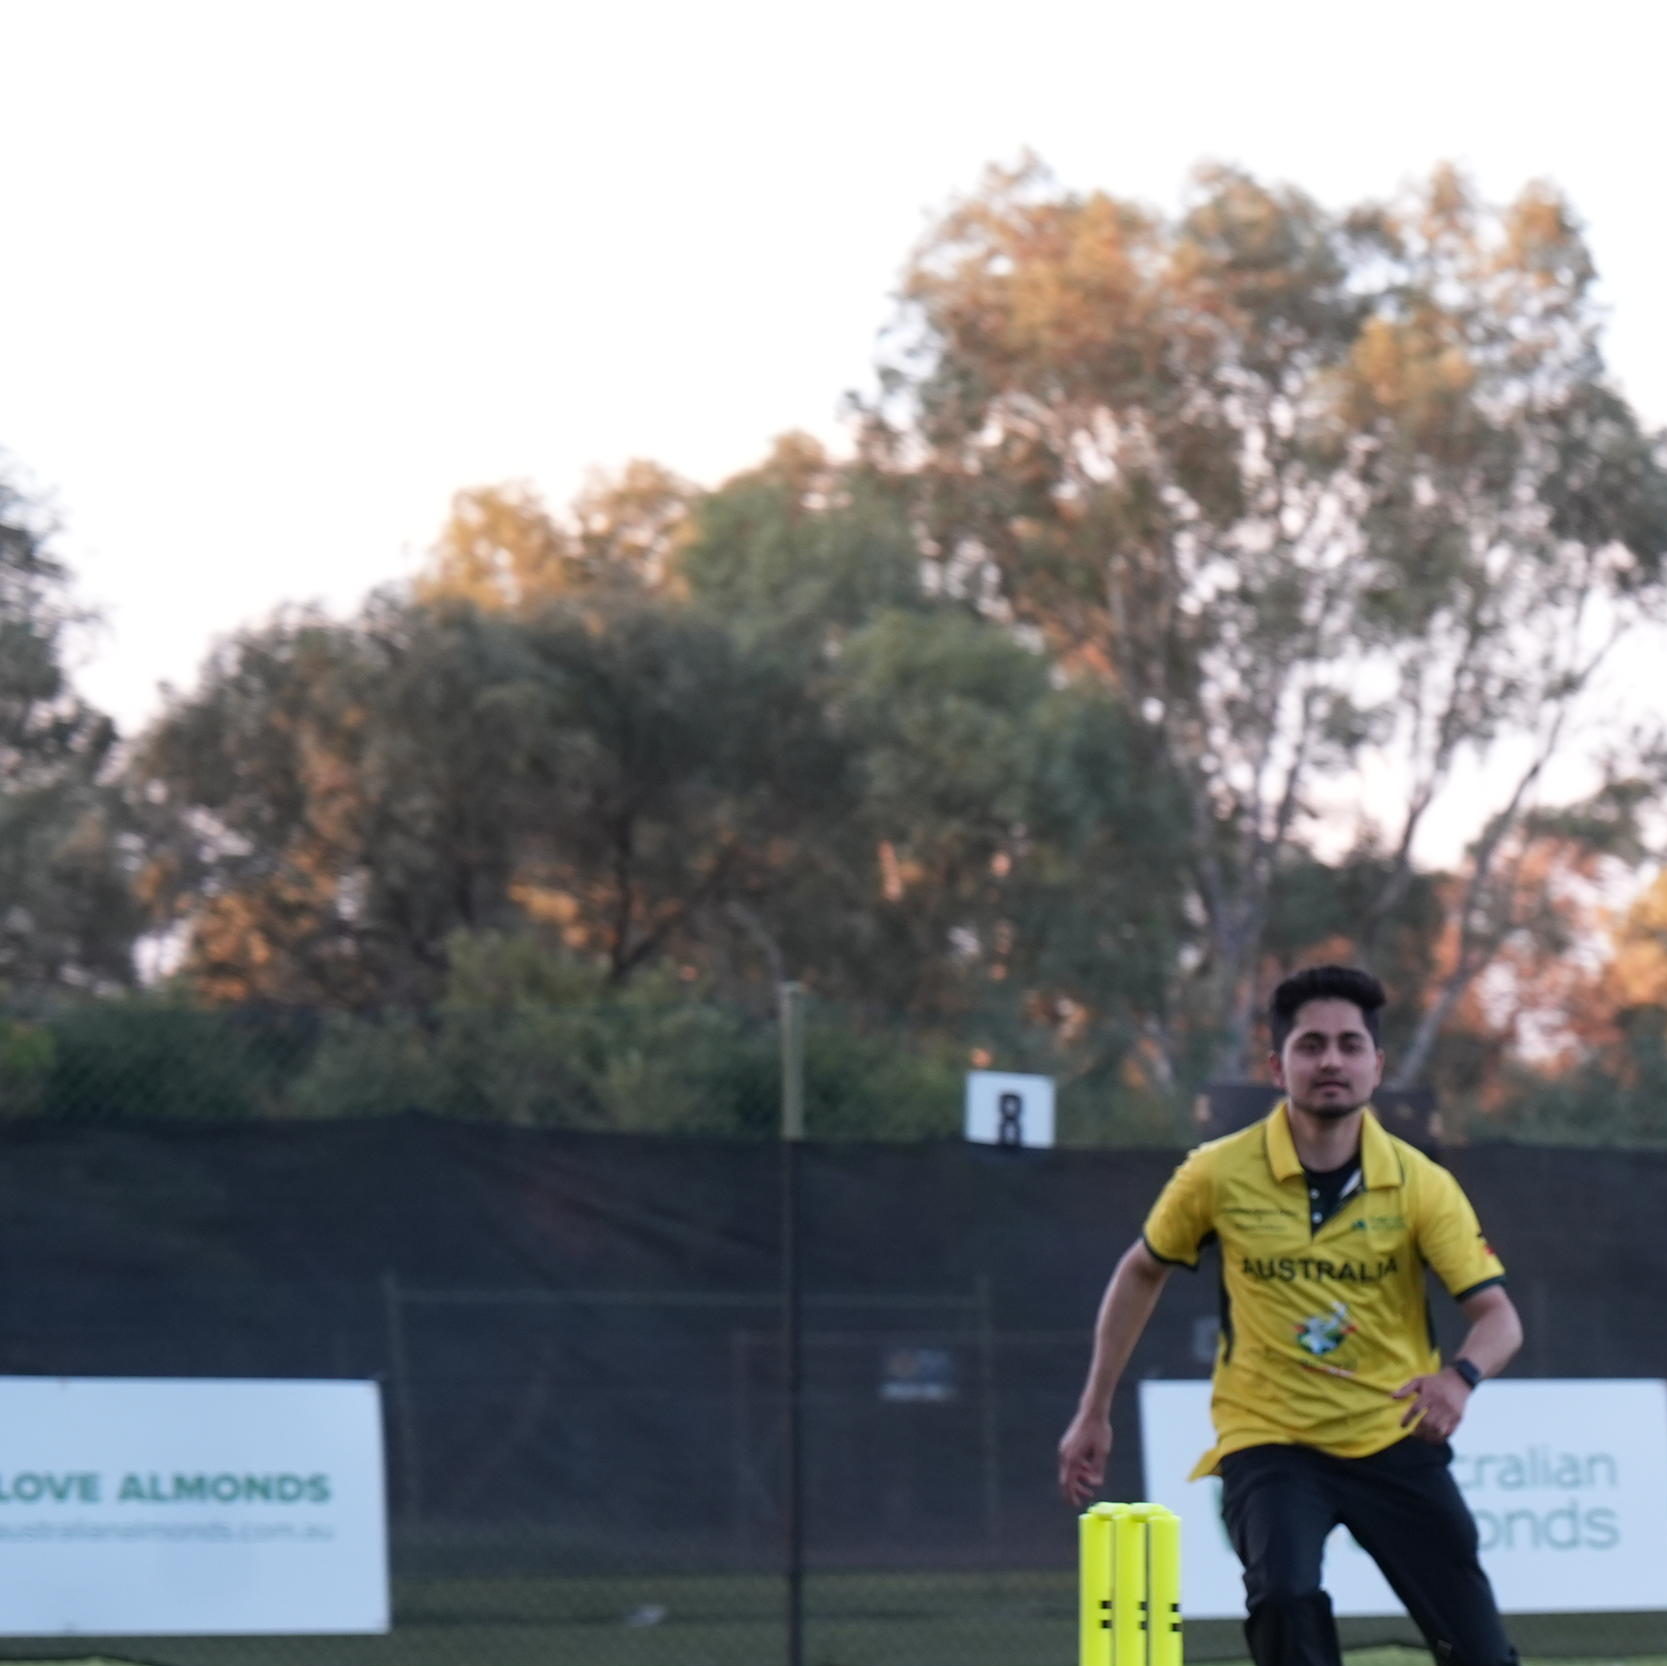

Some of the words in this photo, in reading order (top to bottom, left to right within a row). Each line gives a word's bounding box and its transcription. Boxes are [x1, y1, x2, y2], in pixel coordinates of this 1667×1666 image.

[999, 1094, 1023, 1146] 8
[1242, 1257, 1398, 1283] AUSTRALIA
[117, 1472, 332, 1502] ALMONDS
